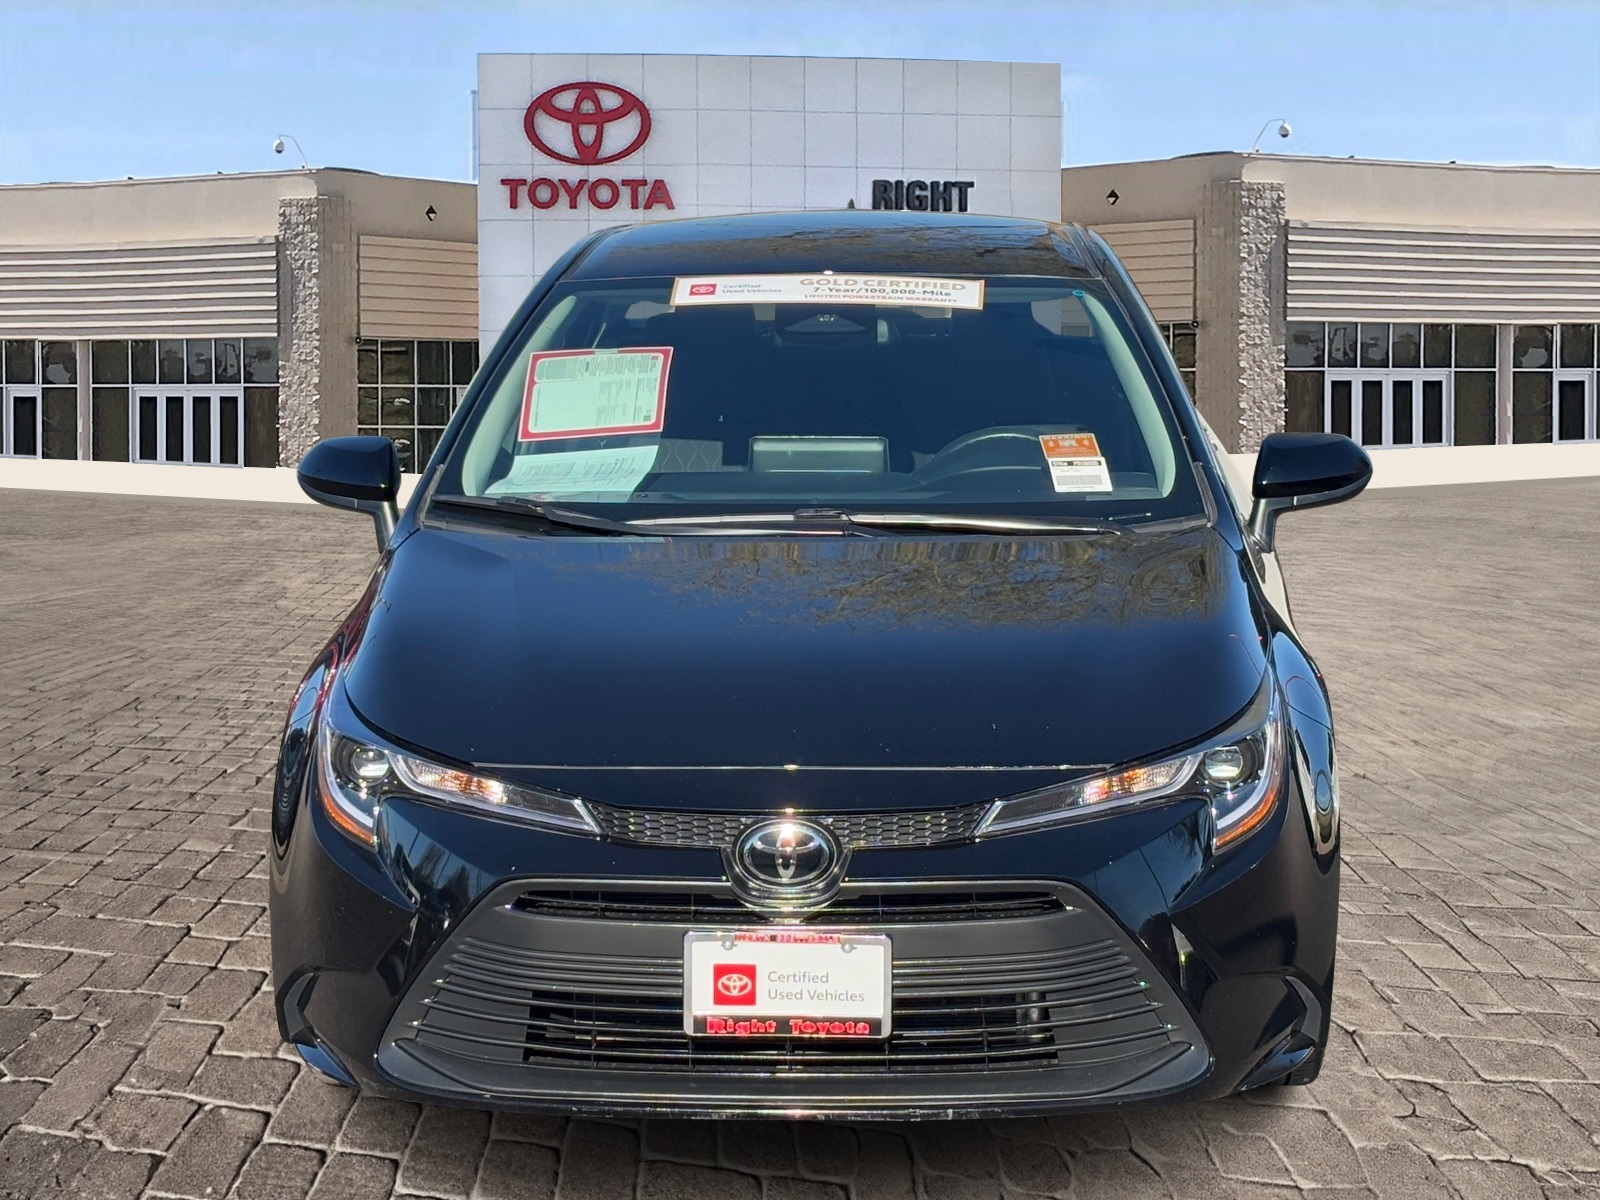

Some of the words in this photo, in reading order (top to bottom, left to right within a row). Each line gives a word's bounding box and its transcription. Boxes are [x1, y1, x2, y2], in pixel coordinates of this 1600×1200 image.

[501, 178, 675, 209] TOYOTA
[872, 180, 974, 212] RIGHT
[800, 278, 858, 286] GOLD
[863, 280, 966, 290] CERTIFIED
[813, 287, 952, 297] 7-Year/100,000-Mile
[767, 970, 830, 984] Certified
[767, 988, 803, 1001] Used
[807, 989, 865, 1002] Vehicles
[706, 1016, 777, 1035] Right
[789, 1018, 871, 1035] Toyota
